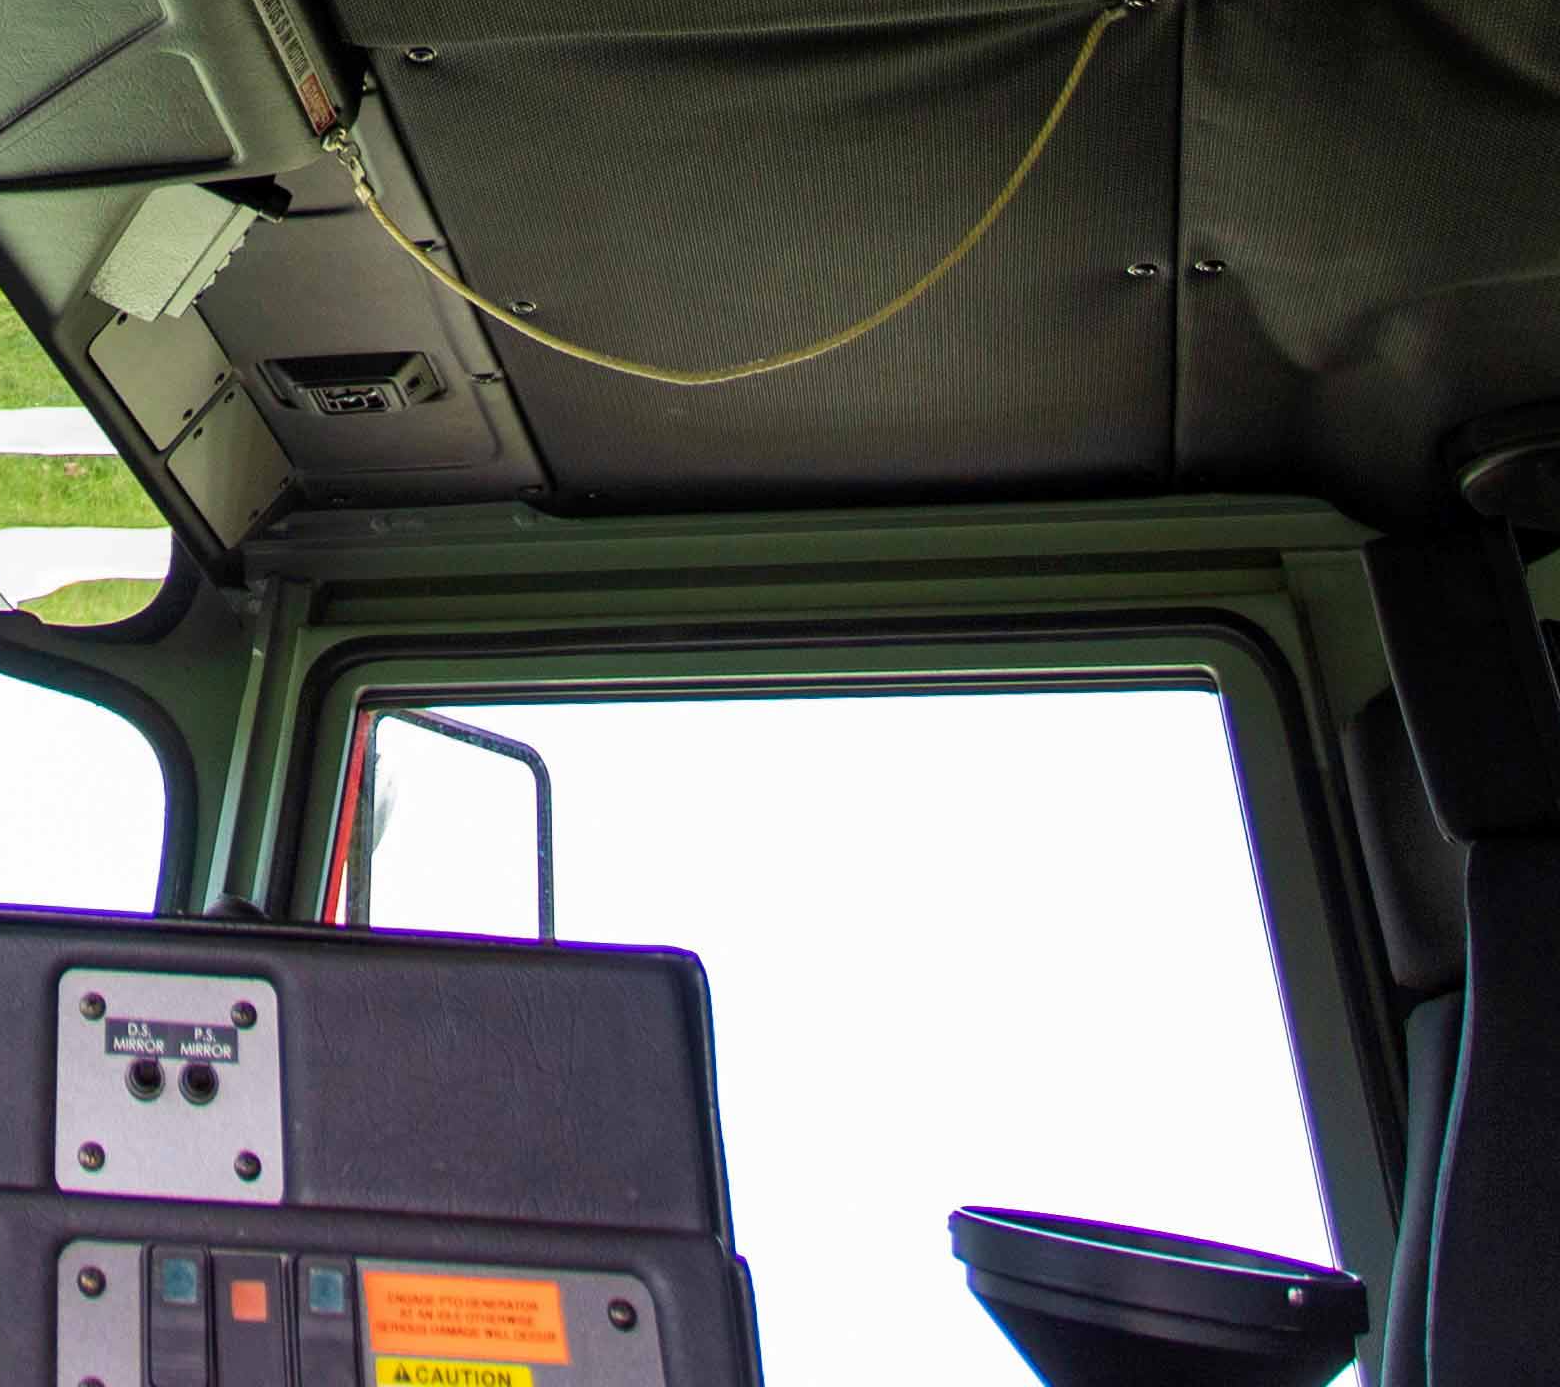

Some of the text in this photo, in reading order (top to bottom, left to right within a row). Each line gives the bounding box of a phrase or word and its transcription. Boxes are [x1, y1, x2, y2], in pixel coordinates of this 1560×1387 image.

[112, 1036, 166, 1055] MIRROR
[180, 1041, 233, 1060] MIRROR
[415, 1365, 513, 1387] CAUTION
